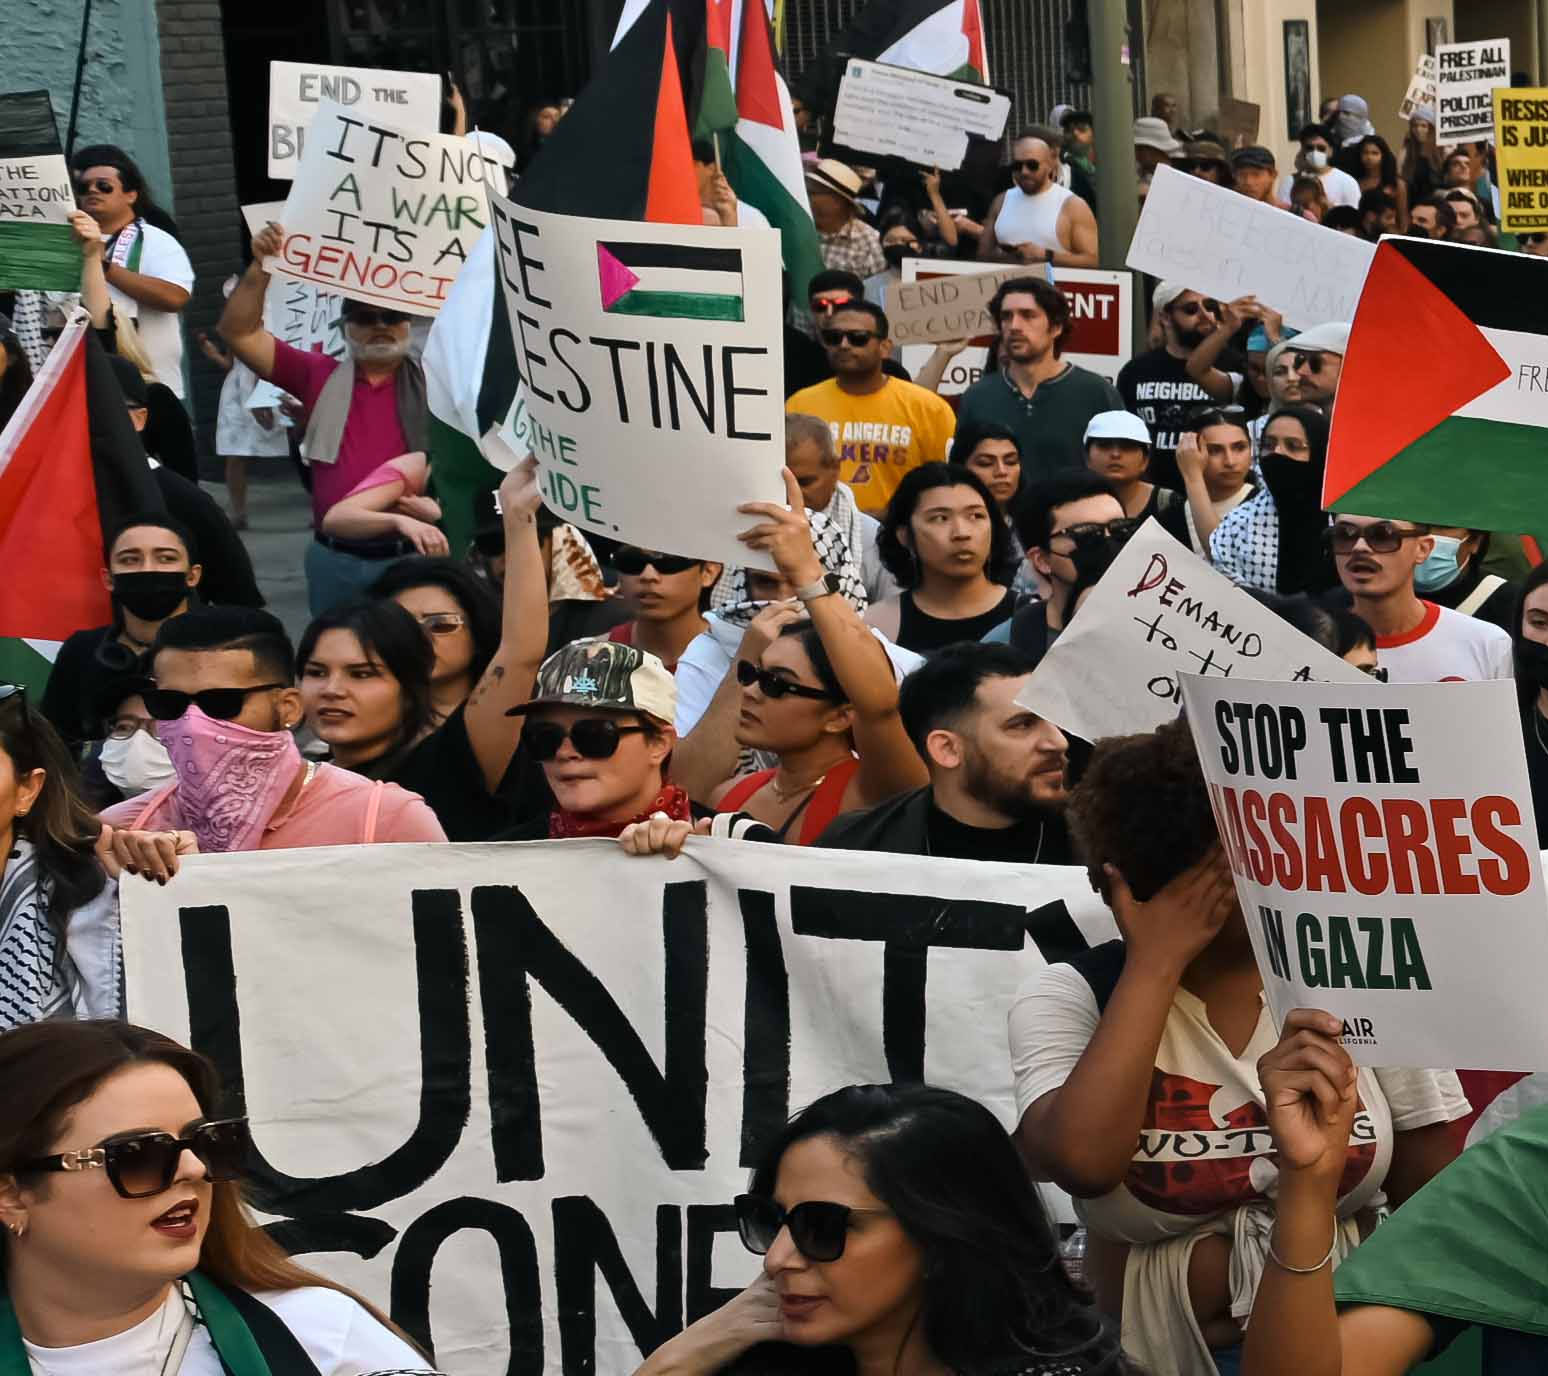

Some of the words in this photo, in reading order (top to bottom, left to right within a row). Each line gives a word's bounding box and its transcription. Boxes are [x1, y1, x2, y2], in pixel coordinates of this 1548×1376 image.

[1439, 49, 1476, 69] FREE
[1480, 47, 1505, 66] ALL
[299, 74, 361, 106] END
[372, 87, 408, 104] THE
[1439, 66, 1506, 84] PALESTINIAN
[326, 115, 430, 180] IT'S
[1502, 125, 1519, 147] IS
[330, 172, 362, 211] A
[391, 186, 486, 231] WAR
[1507, 191, 1535, 209] ARE
[433, 237, 468, 266] A
[899, 278, 959, 311] END
[517, 310, 772, 441] ESTINE
[840, 422, 913, 447] ANGELES
[541, 469, 619, 532] IDE.
[1127, 553, 1263, 659] DEMAND
[1215, 699, 1306, 784] STOP
[1321, 707, 1420, 784] THE
[1257, 906, 1292, 983] IN
[1296, 915, 1434, 991] GAZA
[1341, 1018, 1375, 1037] AIR
